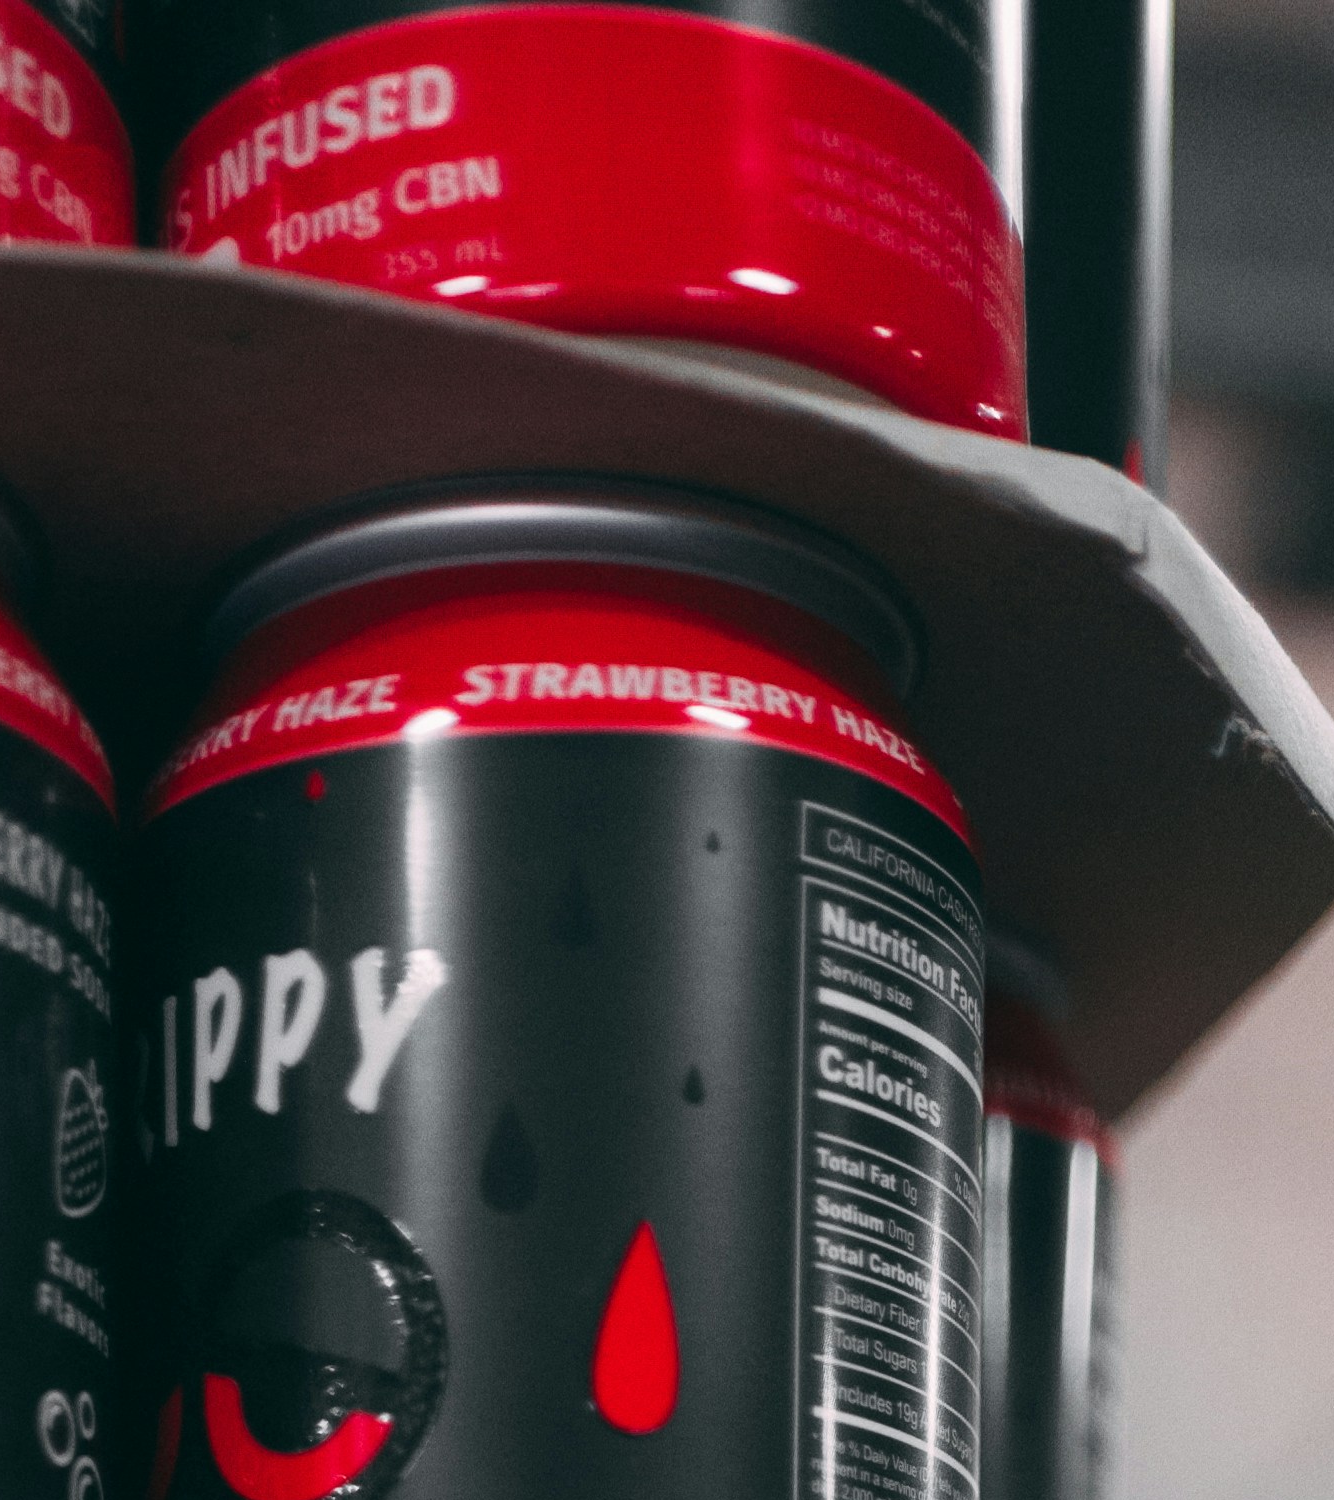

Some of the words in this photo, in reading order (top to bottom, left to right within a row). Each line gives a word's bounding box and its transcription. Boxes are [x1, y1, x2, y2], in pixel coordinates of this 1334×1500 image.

[205, 63, 456, 223] INFUSED
[266, 185, 383, 260] 10mg
[393, 155, 503, 217] CBN
[272, 674, 402, 734] HAZE
[458, 662, 817, 725] STRAWBERRY
[831, 704, 926, 776] HAZE
[820, 901, 945, 991] Nutrition
[819, 955, 883, 1001] Serving
[886, 985, 913, 1012] size
[818, 1046, 941, 1129] Calories
[817, 1148, 864, 1179] Total
[870, 1163, 897, 1192] Fat
[816, 1195, 884, 1232] Sodium
[815, 1237, 863, 1268] Total
[873, 1341, 918, 1375] Sugars
